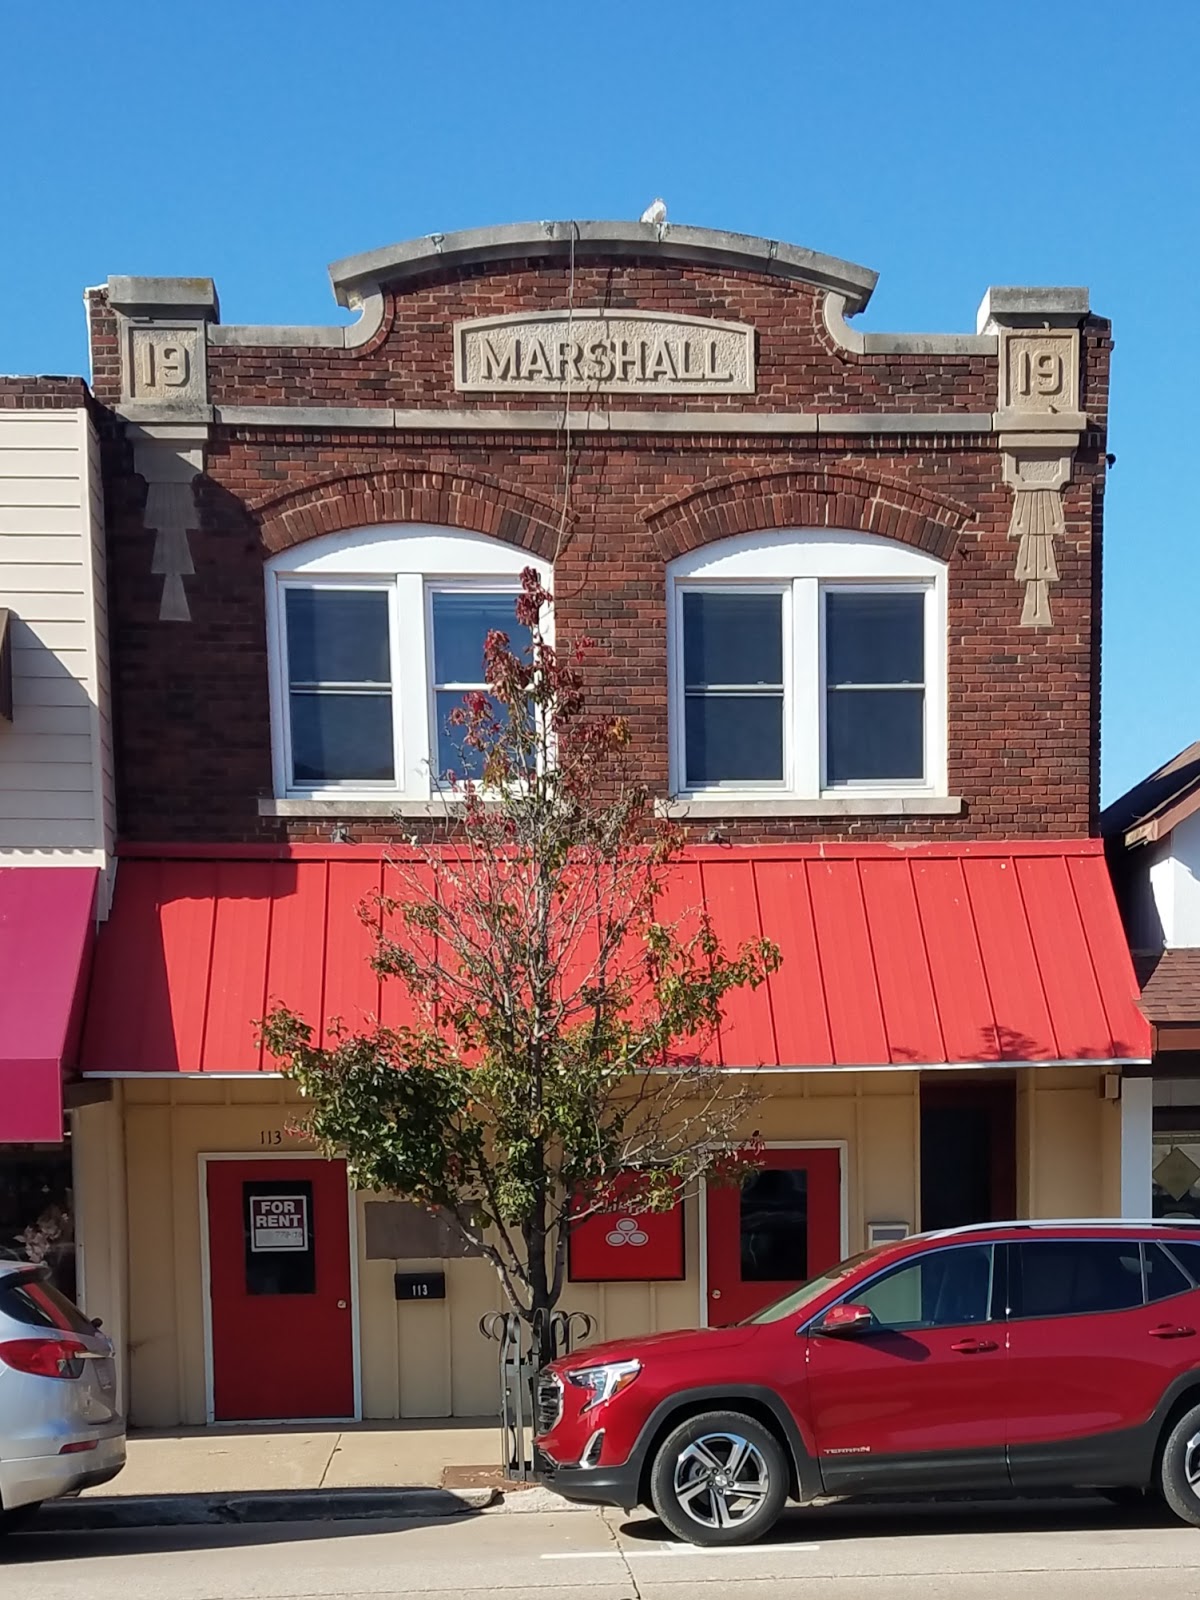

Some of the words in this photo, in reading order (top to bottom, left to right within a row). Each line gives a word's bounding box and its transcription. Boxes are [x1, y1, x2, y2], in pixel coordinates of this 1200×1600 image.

[142, 341, 190, 387] 19
[480, 337, 732, 381] MARSHALL
[1018, 350, 1063, 395] 19
[261, 1130, 282, 1145] 113
[261, 1201, 295, 1214] FOR
[256, 1215, 301, 1227] RENT
[412, 1284, 428, 1296] 113
